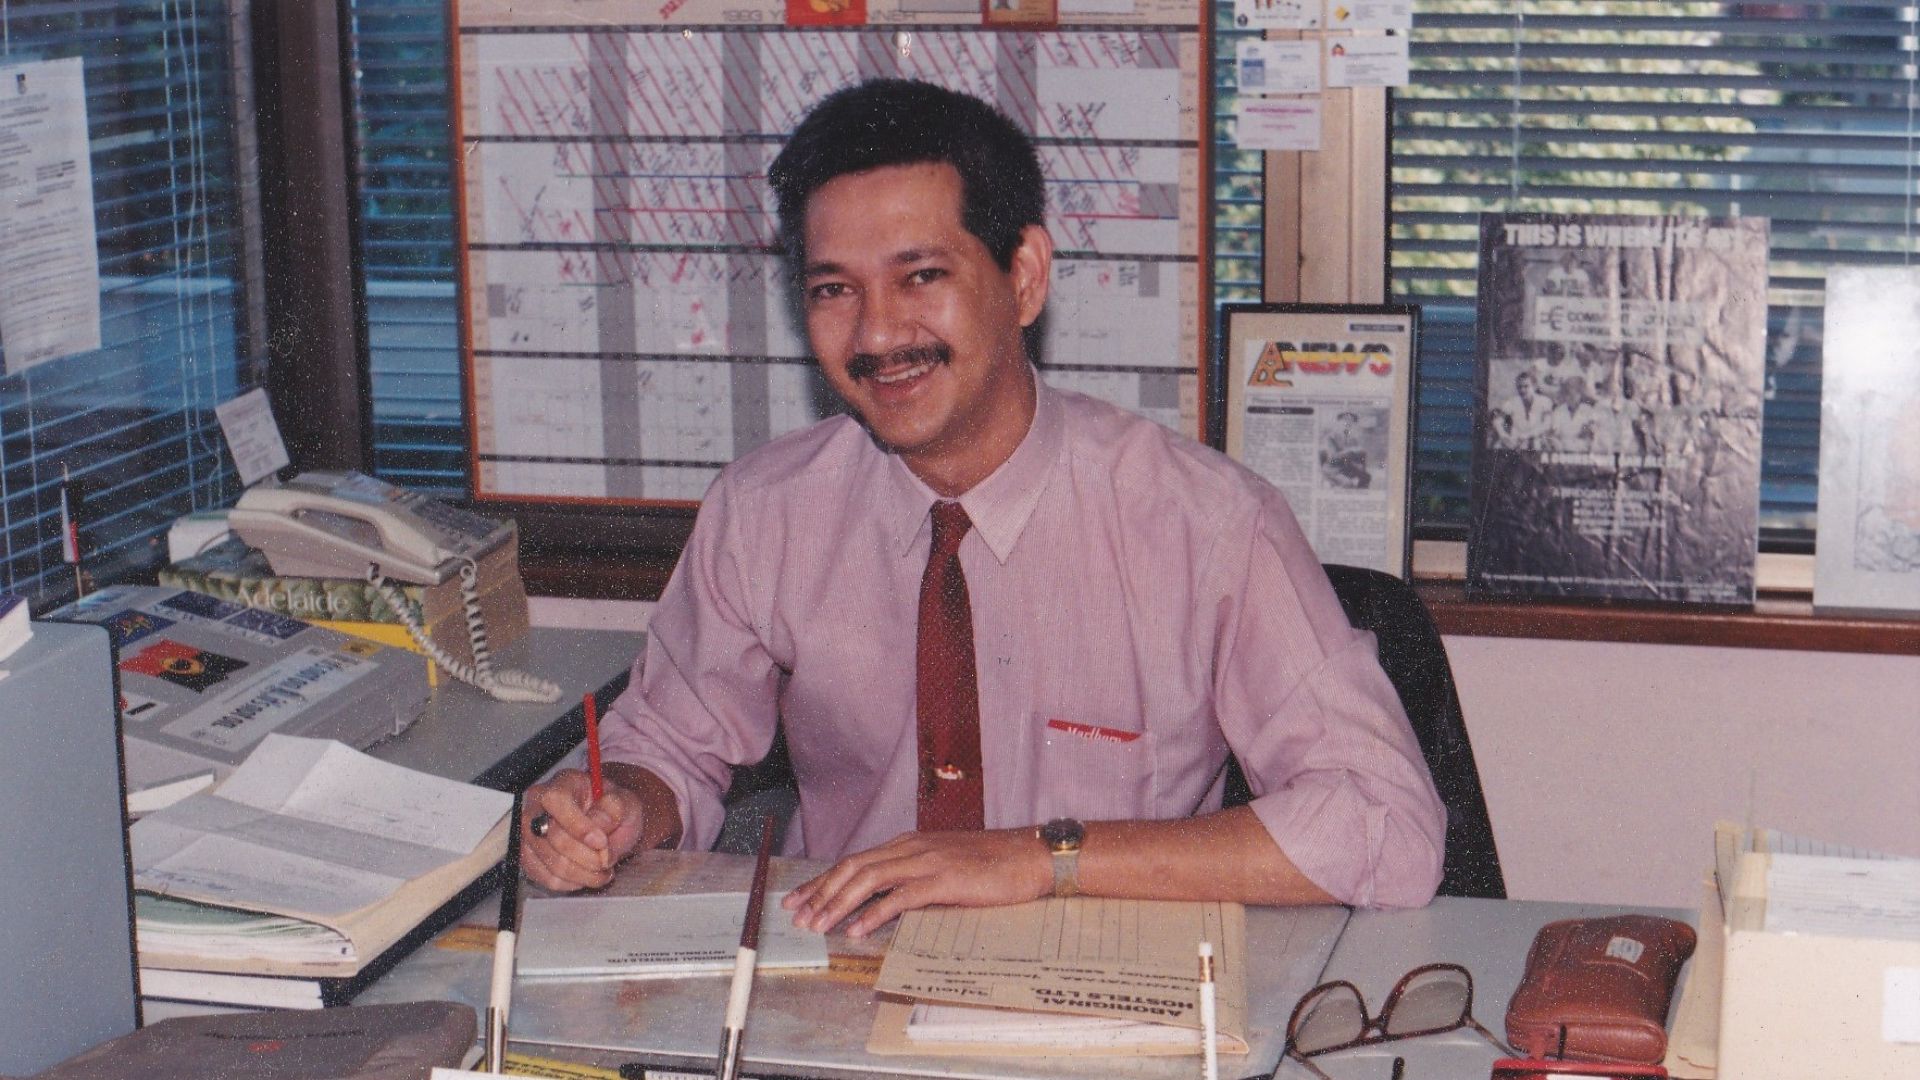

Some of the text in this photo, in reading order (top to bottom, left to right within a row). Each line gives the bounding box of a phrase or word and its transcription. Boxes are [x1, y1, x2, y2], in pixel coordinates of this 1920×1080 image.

[1503, 223, 1556, 247] THIS
[1558, 224, 1582, 247] IS
[1276, 341, 1392, 376] NEWS
[236, 585, 349, 613] Adelaide
[1031, 988, 1193, 1010] HOSTELS LTD.
[1036, 997, 1182, 1015] ABORIGINAL
